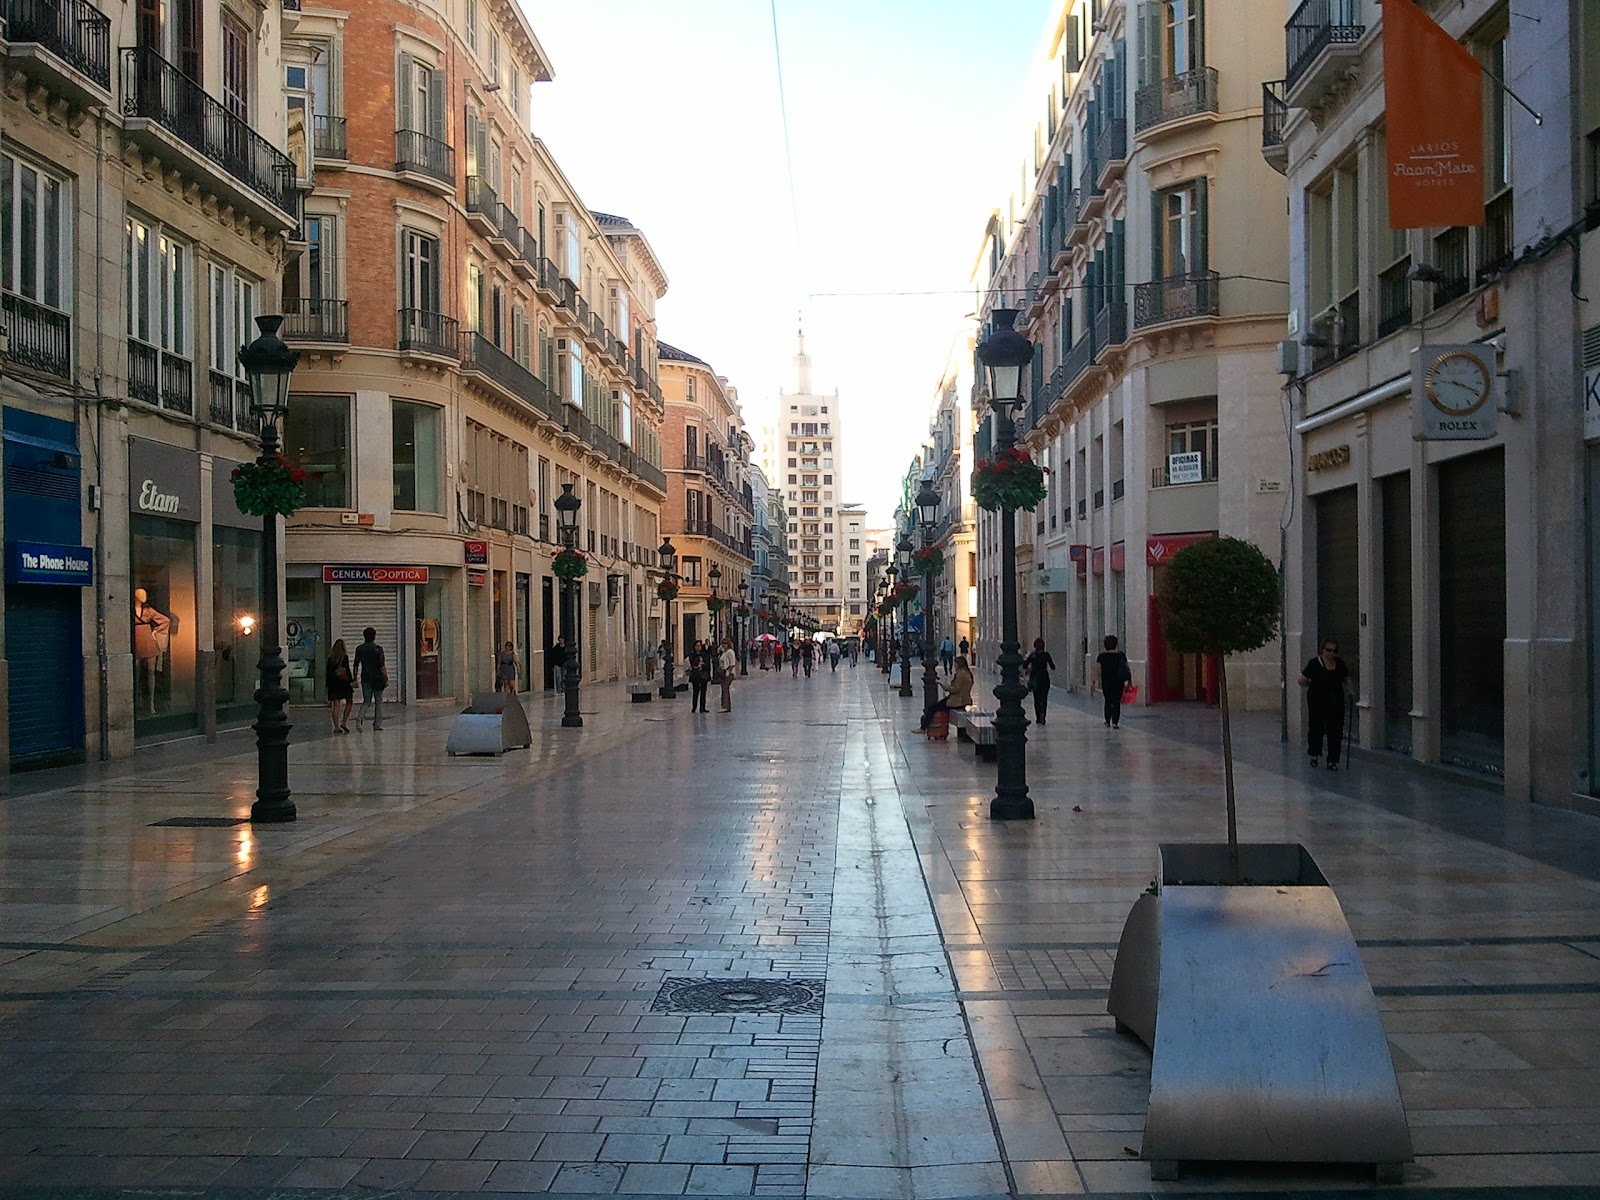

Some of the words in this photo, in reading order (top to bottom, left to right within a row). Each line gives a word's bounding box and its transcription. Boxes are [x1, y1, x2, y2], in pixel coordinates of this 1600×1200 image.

[1410, 142, 1458, 153] LARIOS
[1439, 421, 1477, 431] ROLEX
[1172, 454, 1198, 465] OFICINAS
[139, 480, 179, 513] Etam
[22, 553, 38, 568] The
[40, 554, 64, 570] Phone
[65, 556, 89, 571] House
[331, 569, 372, 579] GENERAL
[388, 570, 421, 579] OPTICA
